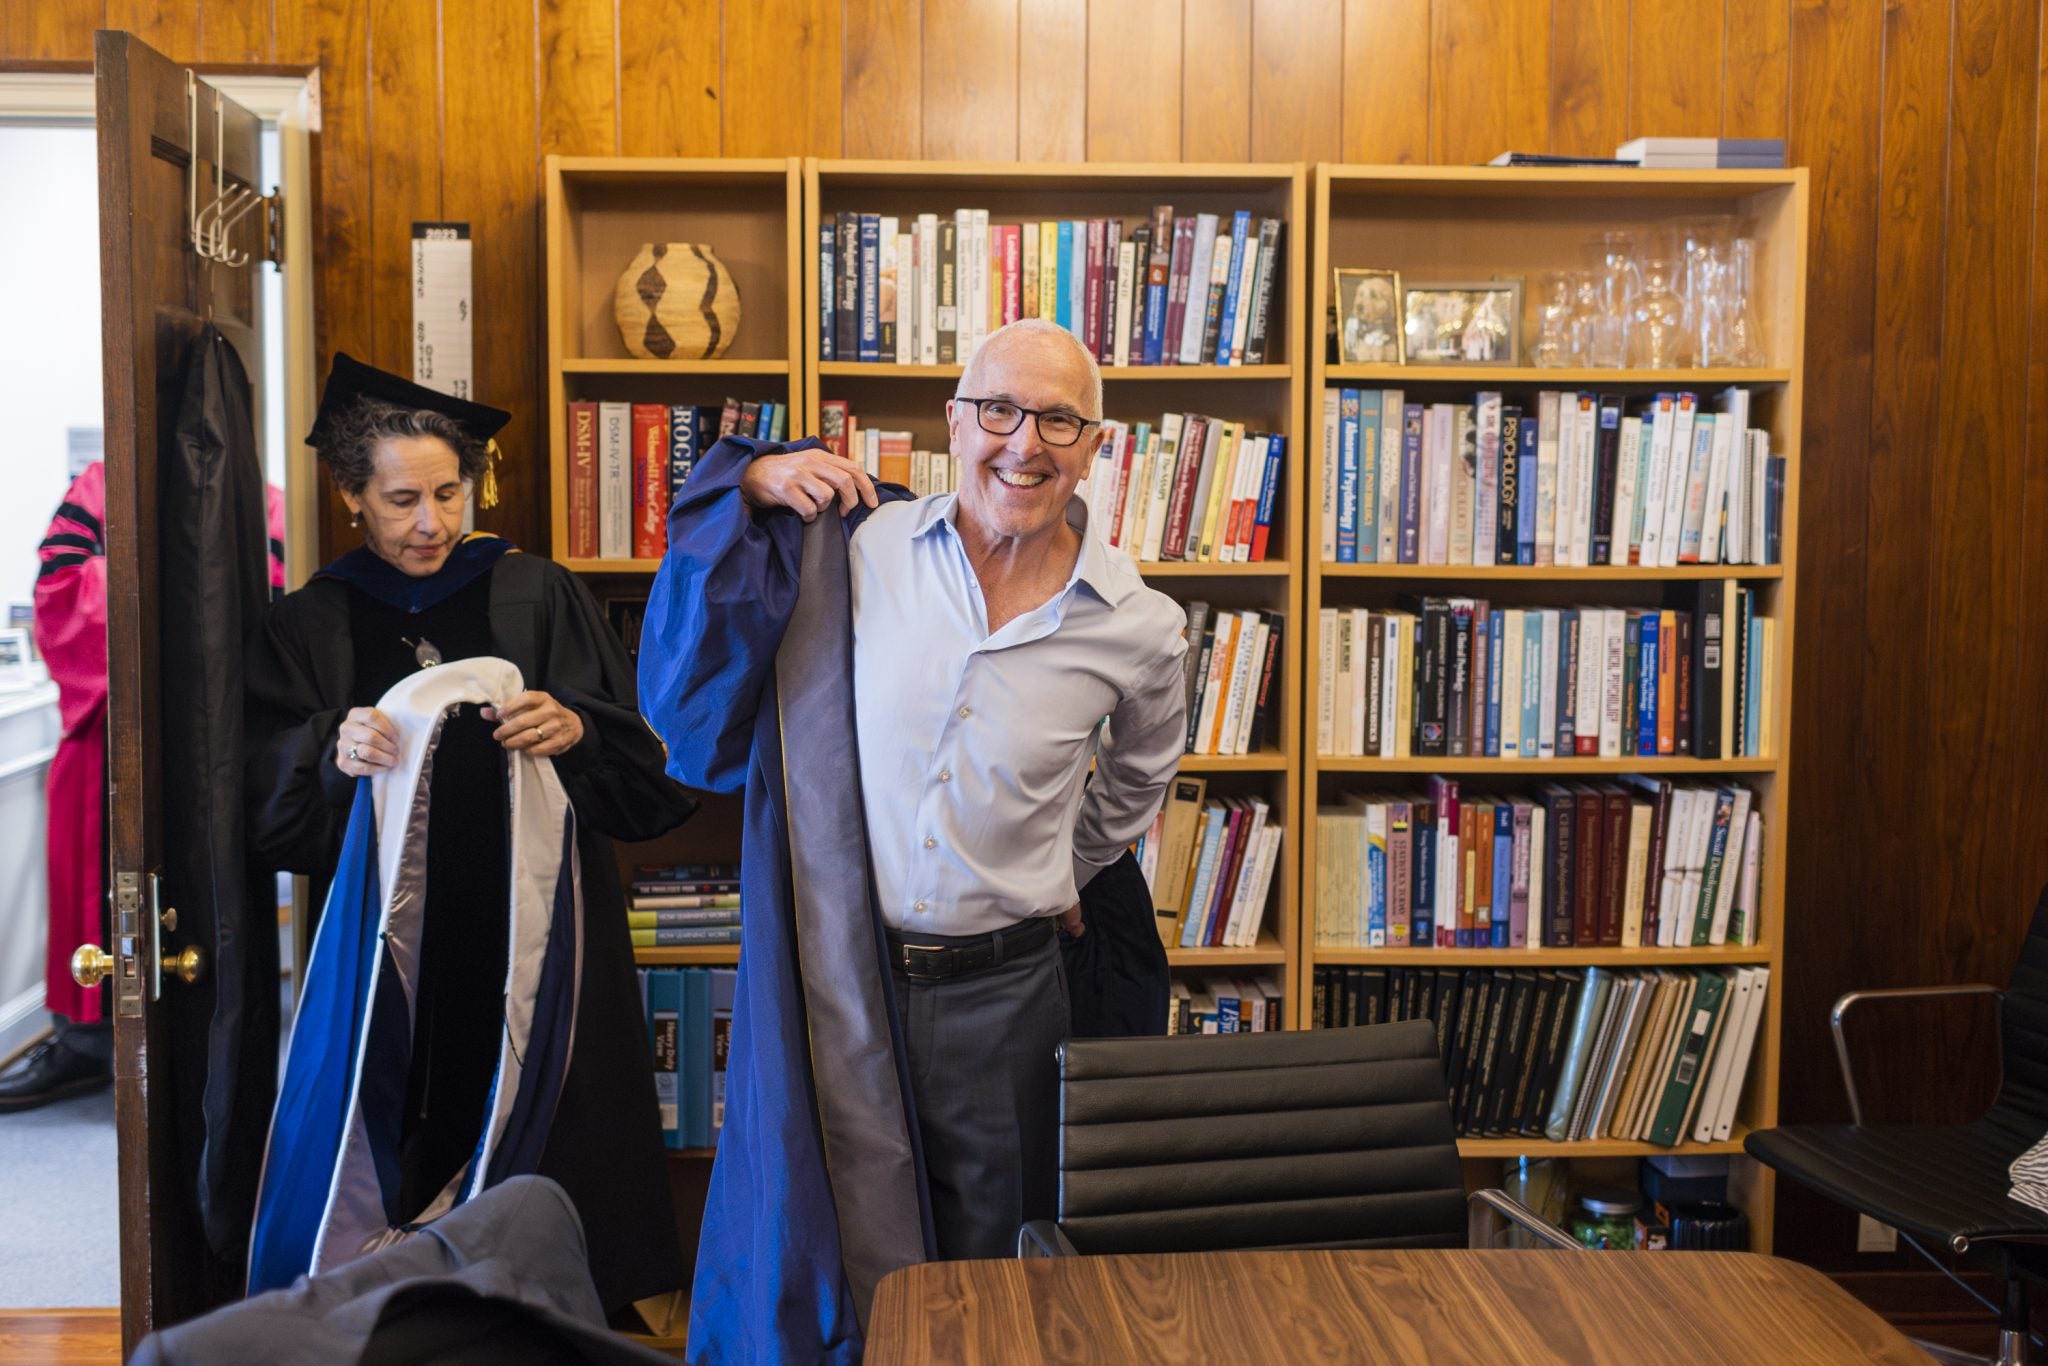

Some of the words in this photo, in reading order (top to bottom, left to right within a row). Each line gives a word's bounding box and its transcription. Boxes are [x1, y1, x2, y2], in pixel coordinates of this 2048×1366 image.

[844, 223, 858, 277] Psychological
[1007, 234, 1017, 271] Lesbian
[843, 279, 858, 310] Testing
[577, 410, 591, 466] DSM-IV
[609, 416, 620, 479] DSM-IV-TR
[1325, 424, 1334, 465] Abnormal
[1344, 421, 1357, 471] Abnormal
[1365, 426, 1375, 470] ABNORMAL
[1162, 457, 1171, 473] The
[1502, 416, 1517, 507] PSYCHOLOGY
[1676, 451, 1684, 471] Social
[1158, 473, 1169, 500] MMPI
[1323, 467, 1333, 514] Psychology
[1340, 472, 1356, 529] Psychology
[1364, 472, 1374, 526] PSYCHOLOGY
[1670, 474, 1682, 513] Psychology
[1168, 528, 1181, 550] Theory
[1248, 624, 1256, 640] THE
[1438, 616, 1446, 664] ASSESSMENT
[1456, 631, 1467, 656] Clinical
[1244, 645, 1252, 666] TEEN
[1607, 636, 1621, 670] CLINICAL
[1640, 642, 1649, 678] Counseling
[1648, 643, 1656, 682] Foundations
[1231, 651, 1244, 698] LINDERMAN
[1438, 667, 1444, 677] OF
[1453, 657, 1466, 692] Psychology
[1234, 670, 1248, 720] WHISPERER
[1370, 657, 1380, 742] PSYCHOLINGUISTICS
[1566, 685, 1576, 717] Psychology
[1606, 674, 1621, 722] PSYCHOLOGY
[1639, 679, 1649, 711] Psychology
[1648, 688, 1656, 711] Clinical
[1419, 830, 1428, 846] Using
[1559, 813, 1569, 850] CHILD
[1712, 828, 1725, 856] Social
[1397, 840, 1407, 885] STATISTICS
[1420, 847, 1428, 878] Multivariate
[1398, 888, 1406, 915] TODAY
[1419, 879, 1427, 904] Statistics
[1557, 852, 1568, 916] Psychopathology
[1701, 857, 1723, 919] Development
[656, 1034, 666, 1057] View
[666, 1021, 676, 1048] Heavy
[716, 1034, 725, 1056] View
[664, 1048, 676, 1070] Duty
